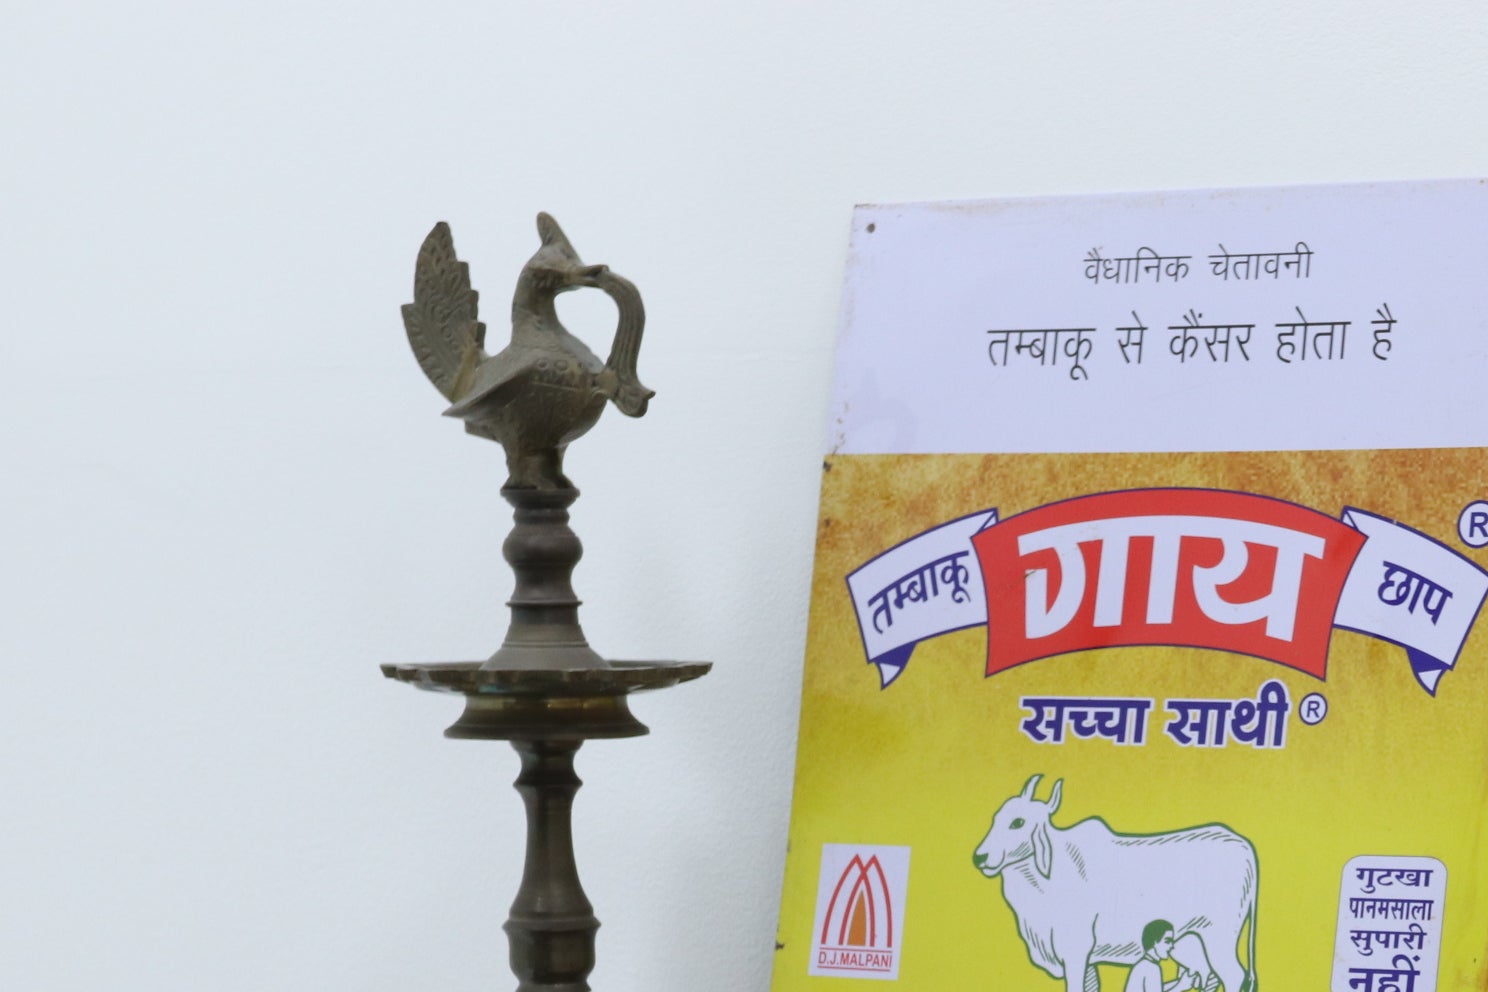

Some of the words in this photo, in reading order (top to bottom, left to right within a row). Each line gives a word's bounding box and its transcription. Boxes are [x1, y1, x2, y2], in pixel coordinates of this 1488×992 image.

[1084, 245, 1192, 285] वैधानिक
[1209, 241, 1313, 280] चेतावनी
[988, 327, 1096, 381] तम्बाकू
[1116, 311, 1148, 365] से
[1168, 307, 1255, 363] कैंसर
[1277, 306, 1351, 363] होता
[1372, 303, 1397, 361] है
[867, 550, 972, 634] तम्बाकू
[1017, 514, 1326, 642] गाय
[1377, 560, 1453, 624] छाप
[1020, 695, 1150, 745] सच्चा
[1165, 680, 1288, 748] साथी
[1356, 868, 1433, 894] गुटखा
[1349, 897, 1434, 921] पानमसाला
[1350, 923, 1427, 956] सुपारी
